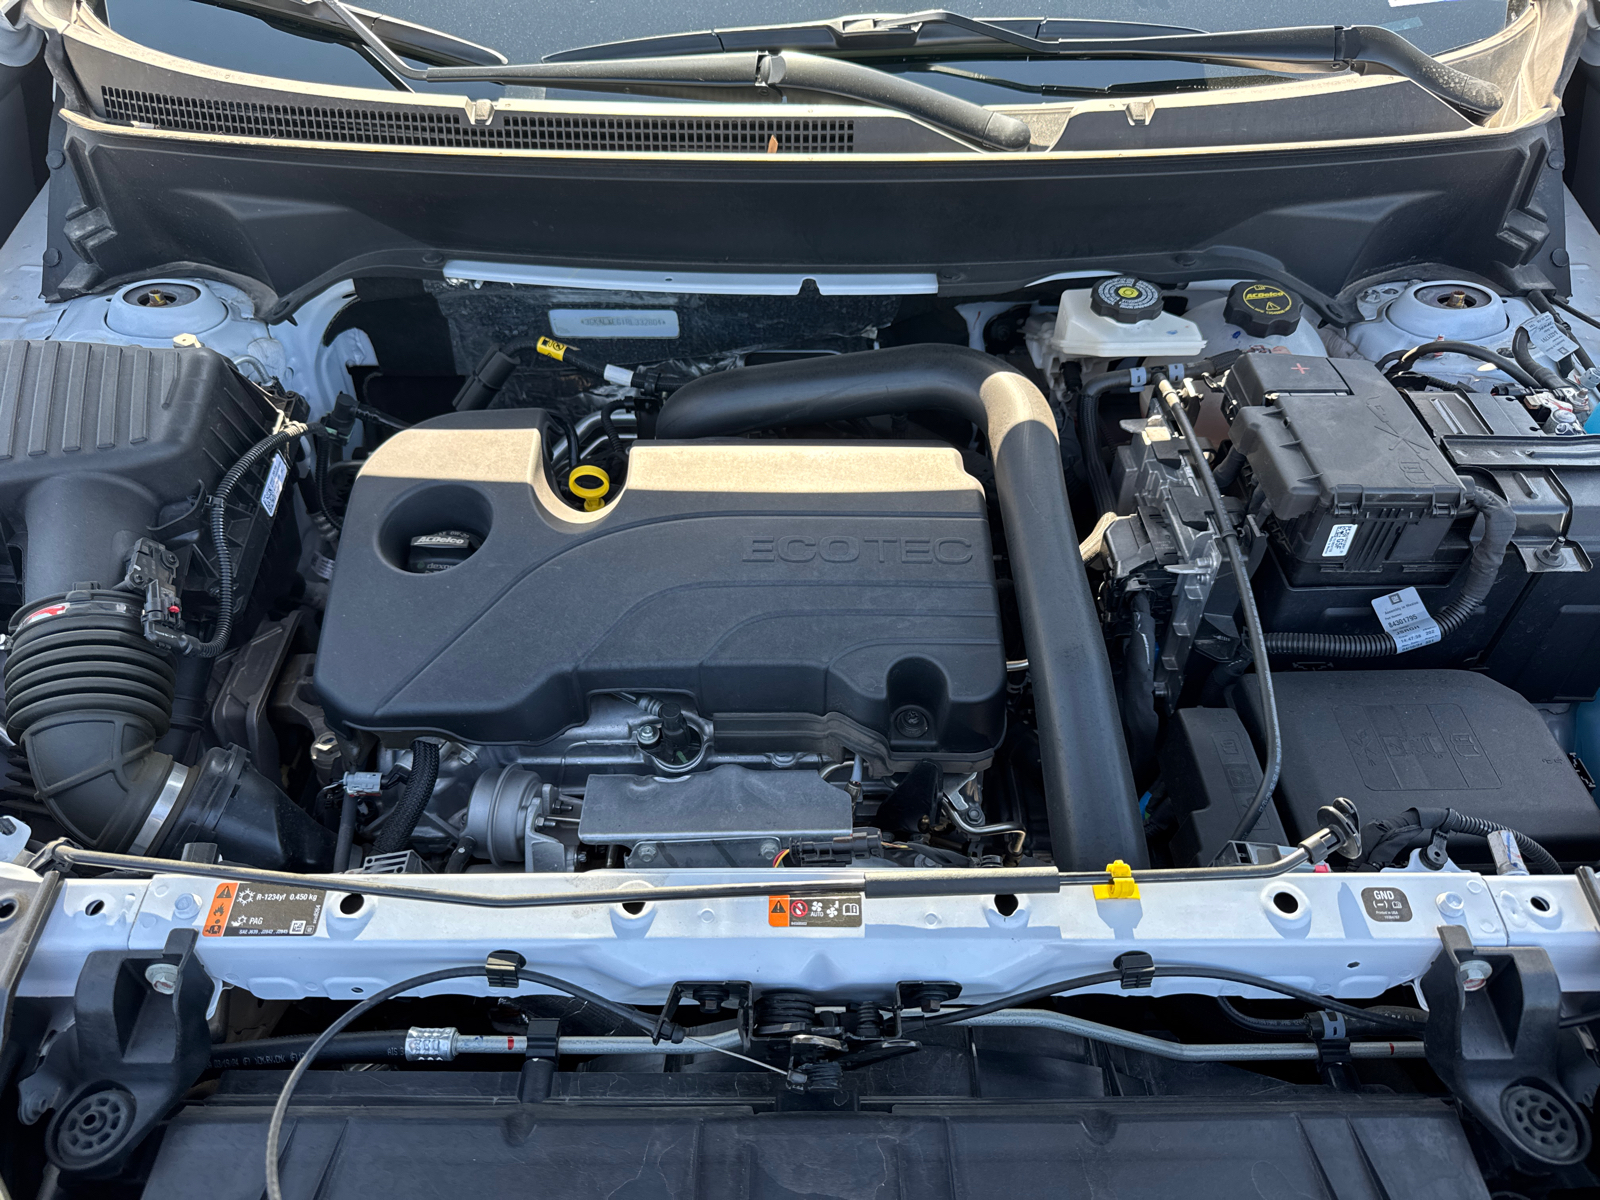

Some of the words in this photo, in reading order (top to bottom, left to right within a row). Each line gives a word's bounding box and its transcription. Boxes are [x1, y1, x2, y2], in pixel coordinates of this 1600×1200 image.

[1246, 290, 1284, 300] ACDelco
[416, 536, 465, 545] ACDelco
[742, 535, 973, 565] ECOTEC
[1387, 614, 1418, 628] 84301795
[256, 893, 287, 902] R-1234yf
[308, 893, 318, 901] kg
[1373, 890, 1395, 900] GND
[248, 917, 264, 925] PAG
